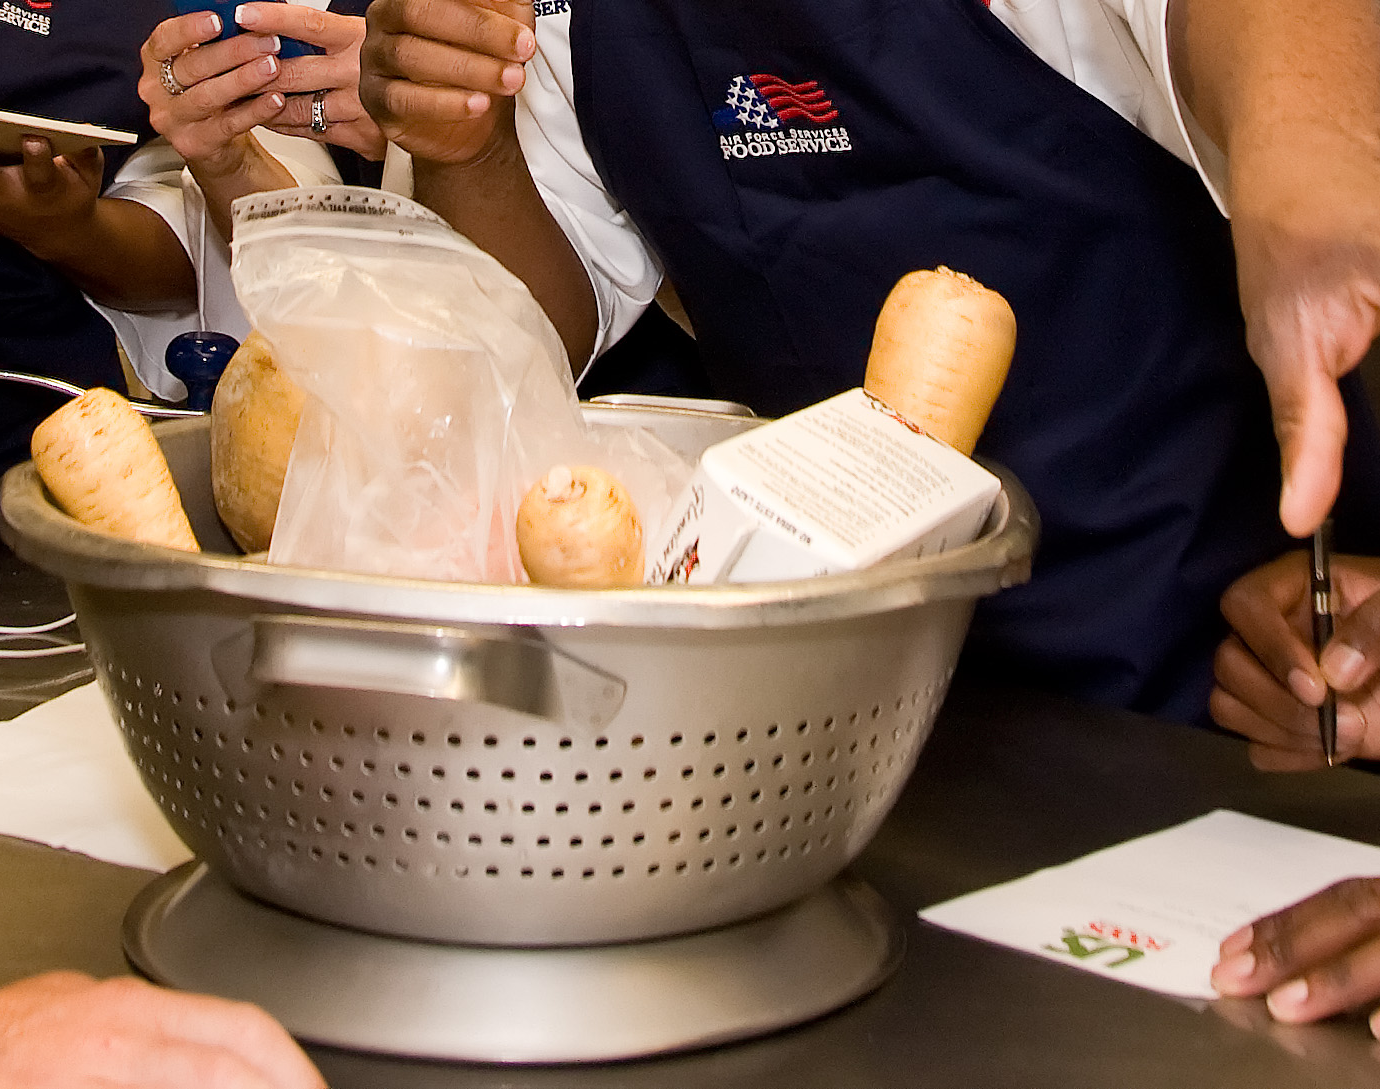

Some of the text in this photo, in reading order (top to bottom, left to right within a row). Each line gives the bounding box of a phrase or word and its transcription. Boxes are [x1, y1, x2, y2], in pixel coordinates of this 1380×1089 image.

[2, 1, 51, 25] SERVICES
[720, 127, 850, 146] AIR FORCE SERVICES
[720, 136, 852, 160] FOOD SERVICE
